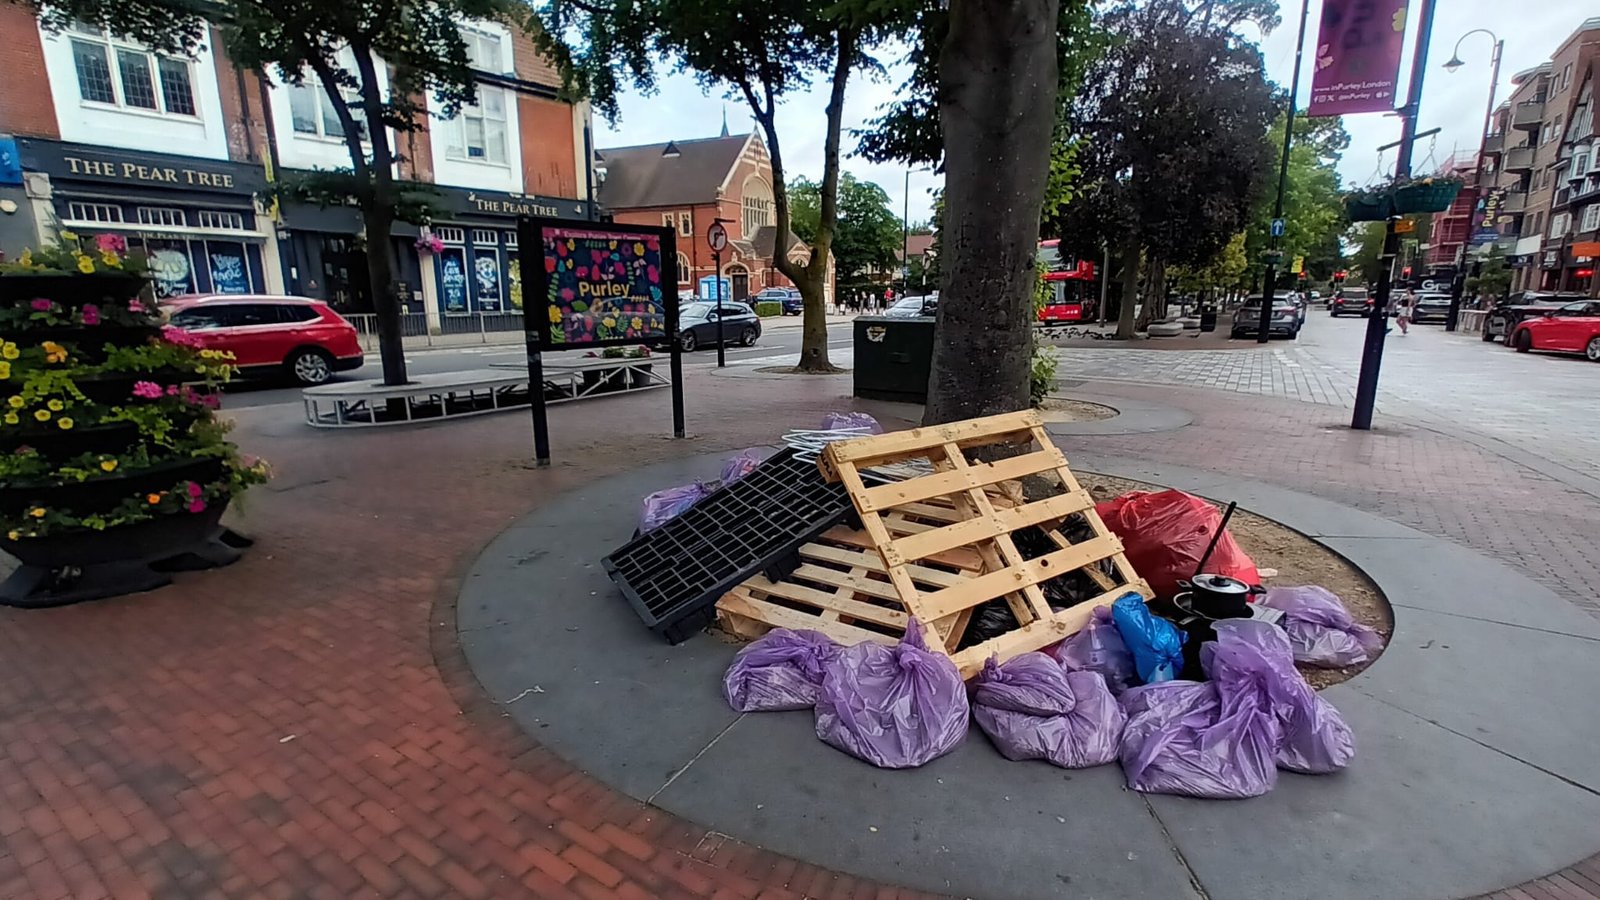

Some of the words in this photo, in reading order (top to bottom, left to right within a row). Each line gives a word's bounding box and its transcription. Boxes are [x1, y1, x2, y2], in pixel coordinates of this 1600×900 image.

[64, 157, 116, 177] THE
[122, 163, 178, 183] PEAR
[183, 169, 234, 188] TREE
[475, 199, 499, 212] THE
[503, 201, 530, 214] PEAR
[532, 204, 558, 217] TREE
[1482, 190, 1499, 227] Purley
[578, 281, 630, 299] Purley
